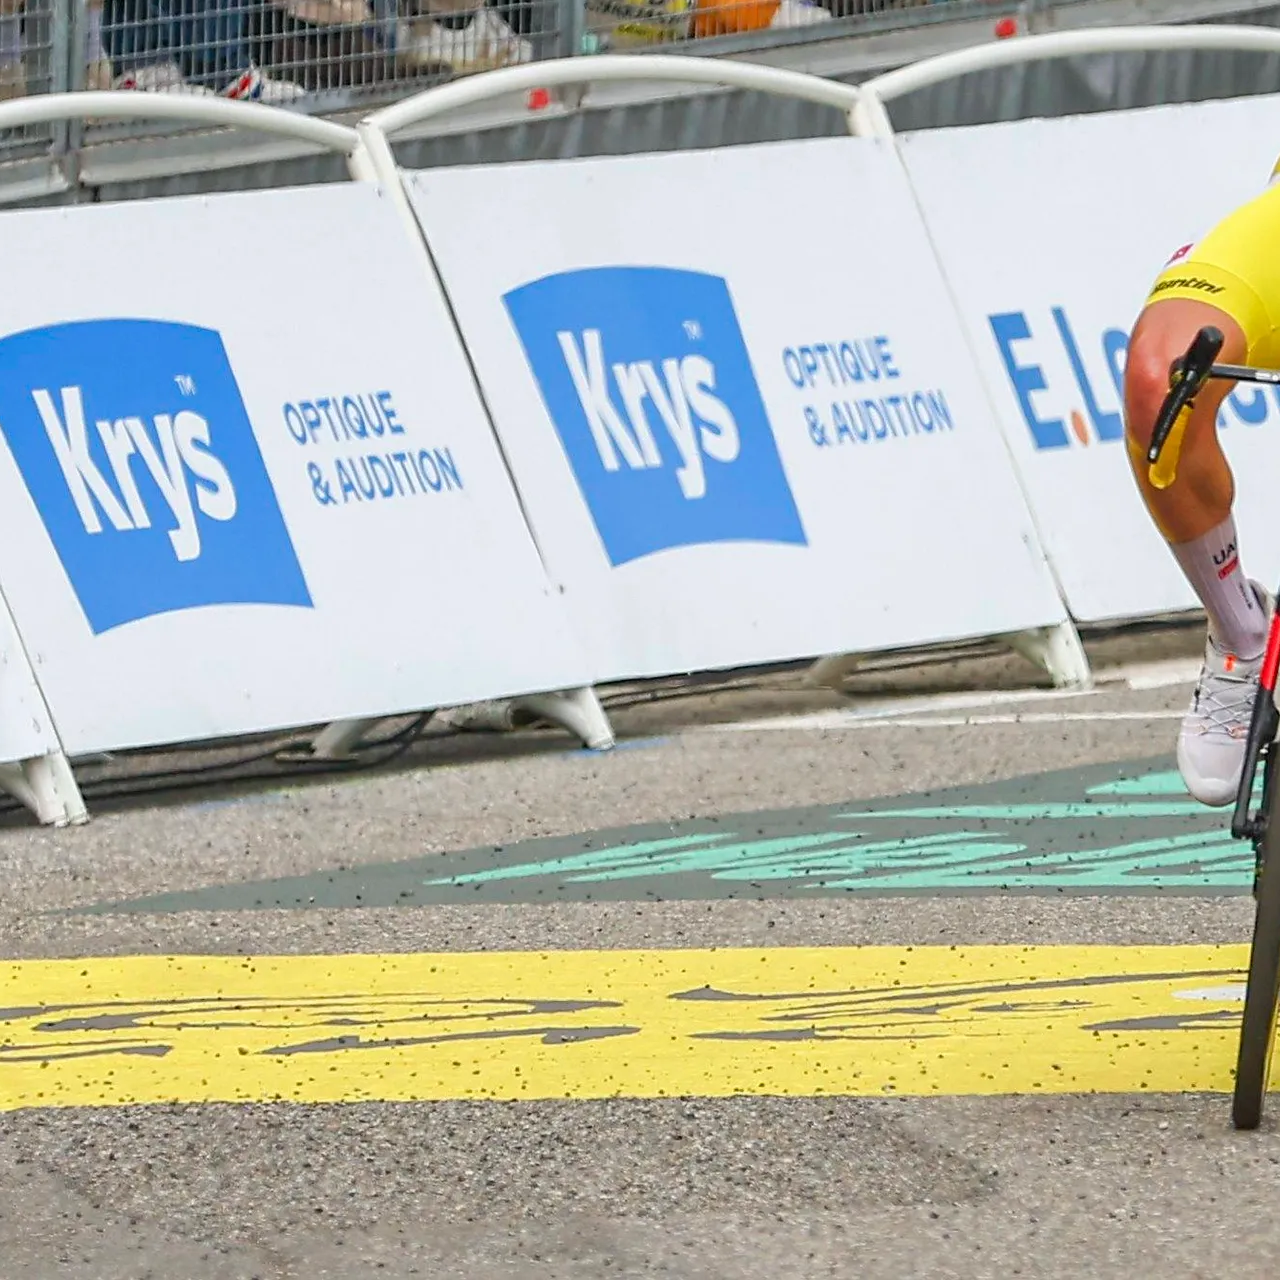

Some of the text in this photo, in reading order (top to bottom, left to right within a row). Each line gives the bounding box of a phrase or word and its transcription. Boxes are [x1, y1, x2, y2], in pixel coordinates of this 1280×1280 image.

[782, 335, 899, 391] OPTIQUE
[282, 391, 405, 446] OPTIQUE
[556, 328, 741, 500] Krys
[805, 389, 955, 449] & AUDITION
[31, 385, 237, 563] Krys
[307, 446, 464, 508] & AUDITION
[1211, 537, 1238, 566] UA
